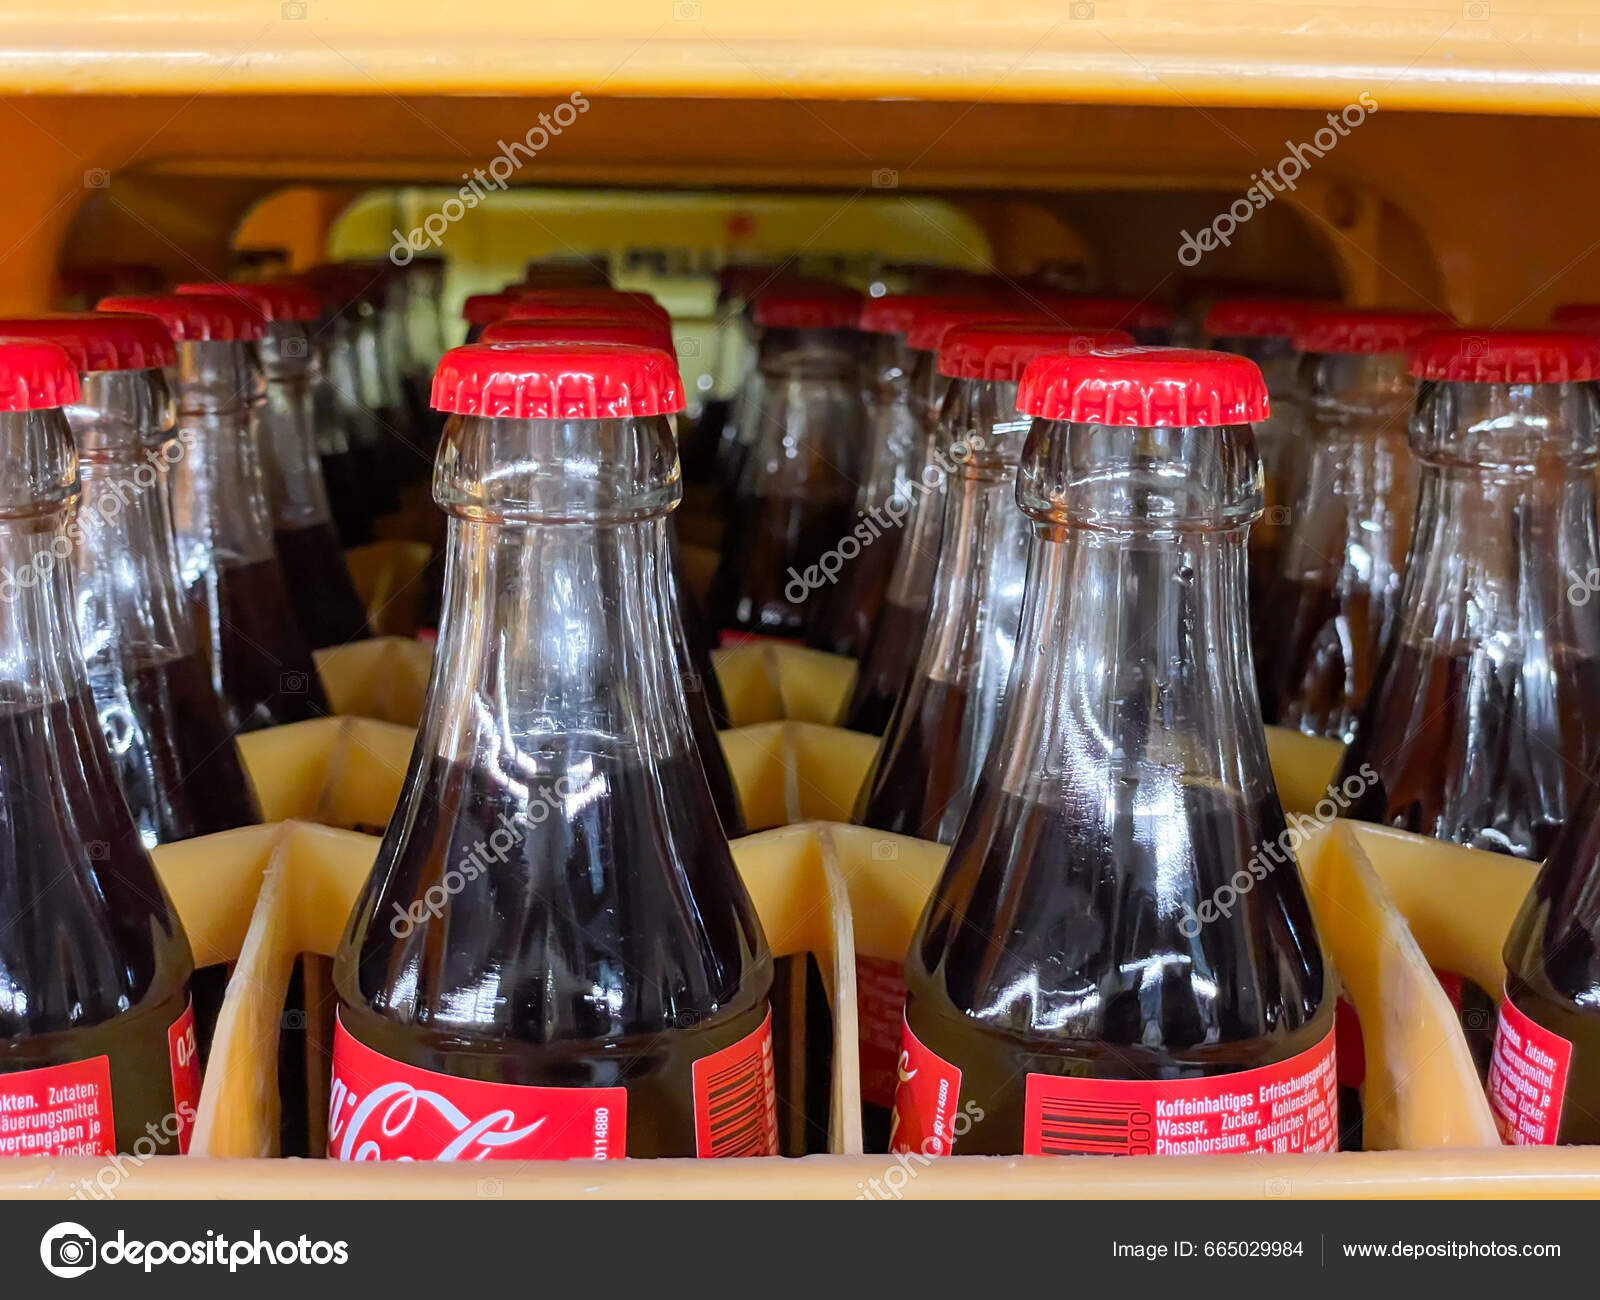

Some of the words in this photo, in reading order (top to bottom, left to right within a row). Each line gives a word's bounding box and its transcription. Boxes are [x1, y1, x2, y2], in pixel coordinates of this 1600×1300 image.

[1523, 1039, 1558, 1073] Zutaten:
[0, 1093, 39, 1112] kten.
[48, 1082, 99, 1105] Zutaten:
[1156, 1092, 1254, 1117] Koffeinhaltiges
[1518, 1095, 1547, 1126] Zucker:
[1540, 1089, 1551, 1108] je
[89, 1118, 101, 1140] je
[1156, 1119, 1208, 1137] Wasser,
[1221, 1110, 1262, 1131] Zucker,
[1156, 1132, 1249, 1156] Phosphorsäure,
[1255, 1112, 1304, 1142] natürliches
[1519, 1115, 1544, 1143] Eiweiß
[1272, 1136, 1288, 1154] 180
[1290, 1130, 1300, 1150] kJ
